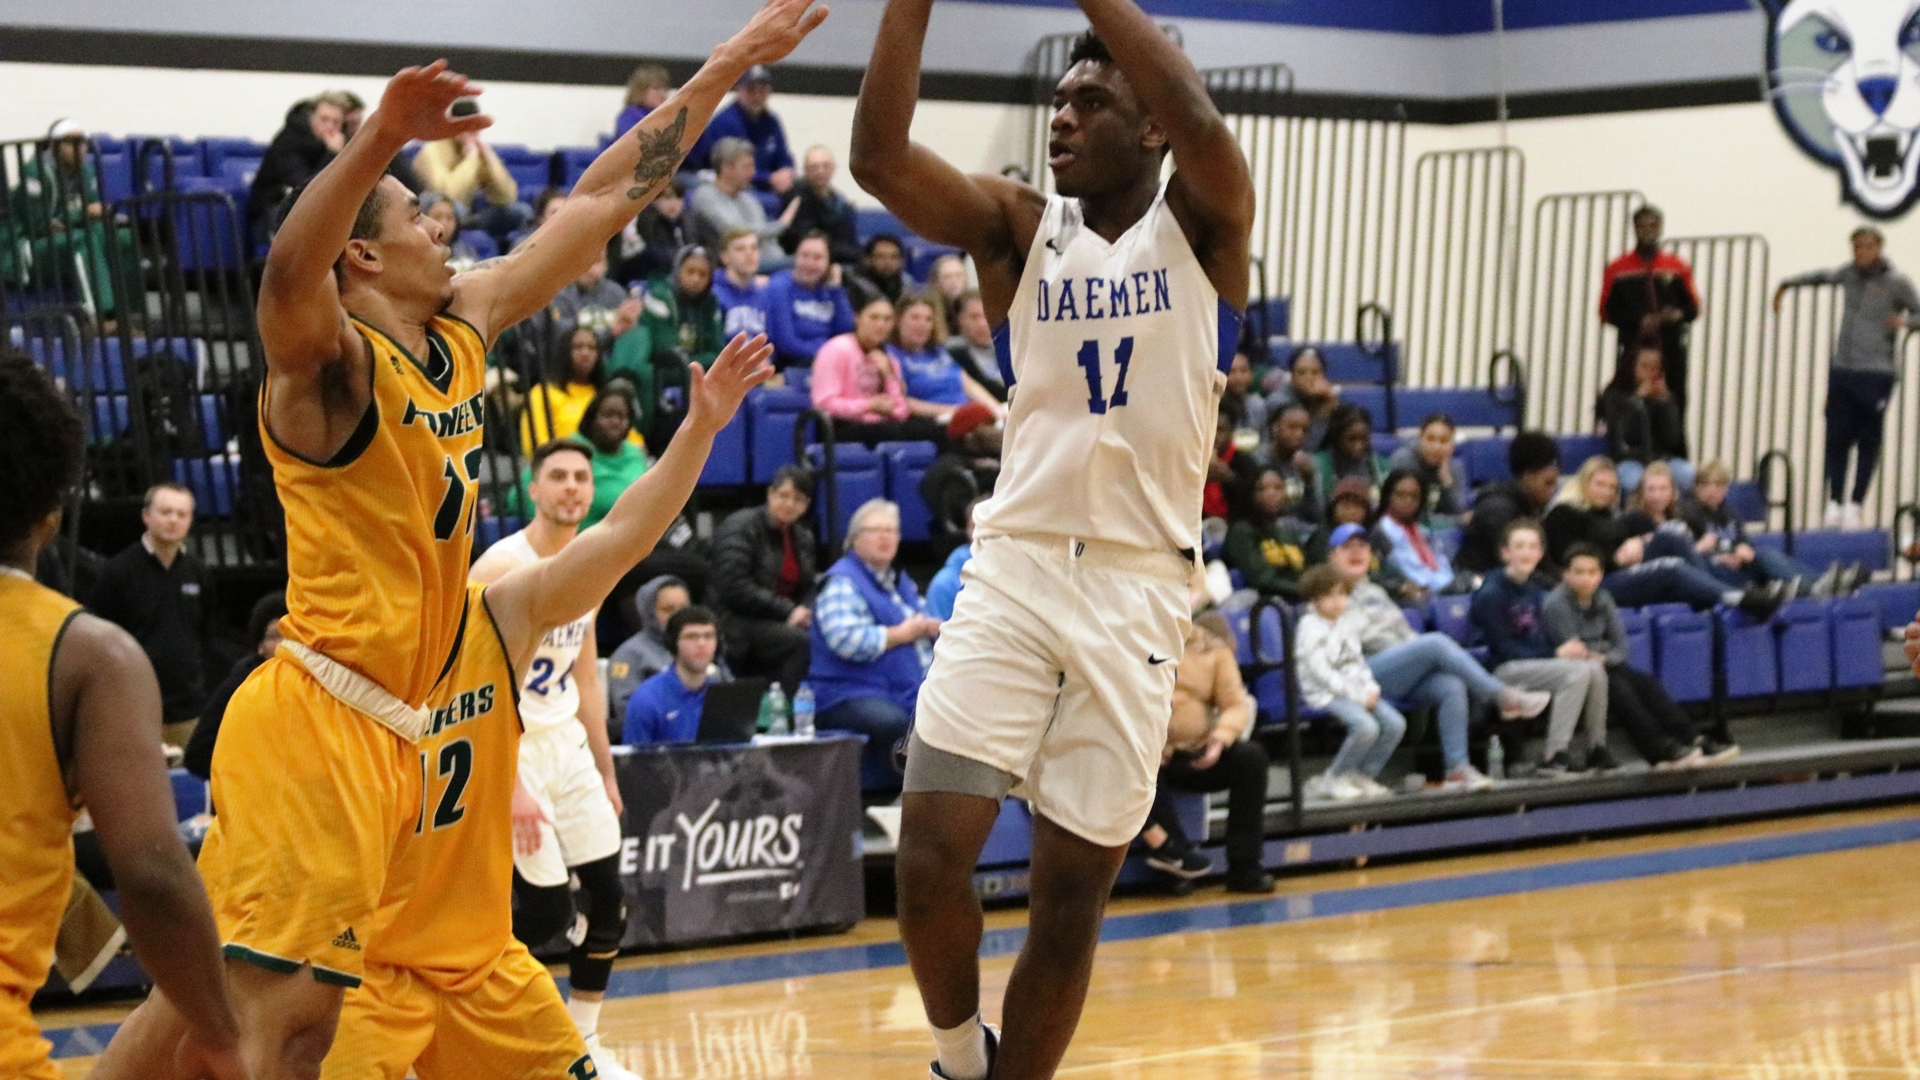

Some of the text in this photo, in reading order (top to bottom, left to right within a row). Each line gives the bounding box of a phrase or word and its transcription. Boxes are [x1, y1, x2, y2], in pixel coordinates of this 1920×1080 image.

[1037, 267, 1172, 322] DAEMEN
[1077, 335, 1134, 415] 11
[645, 834, 677, 873] IT
